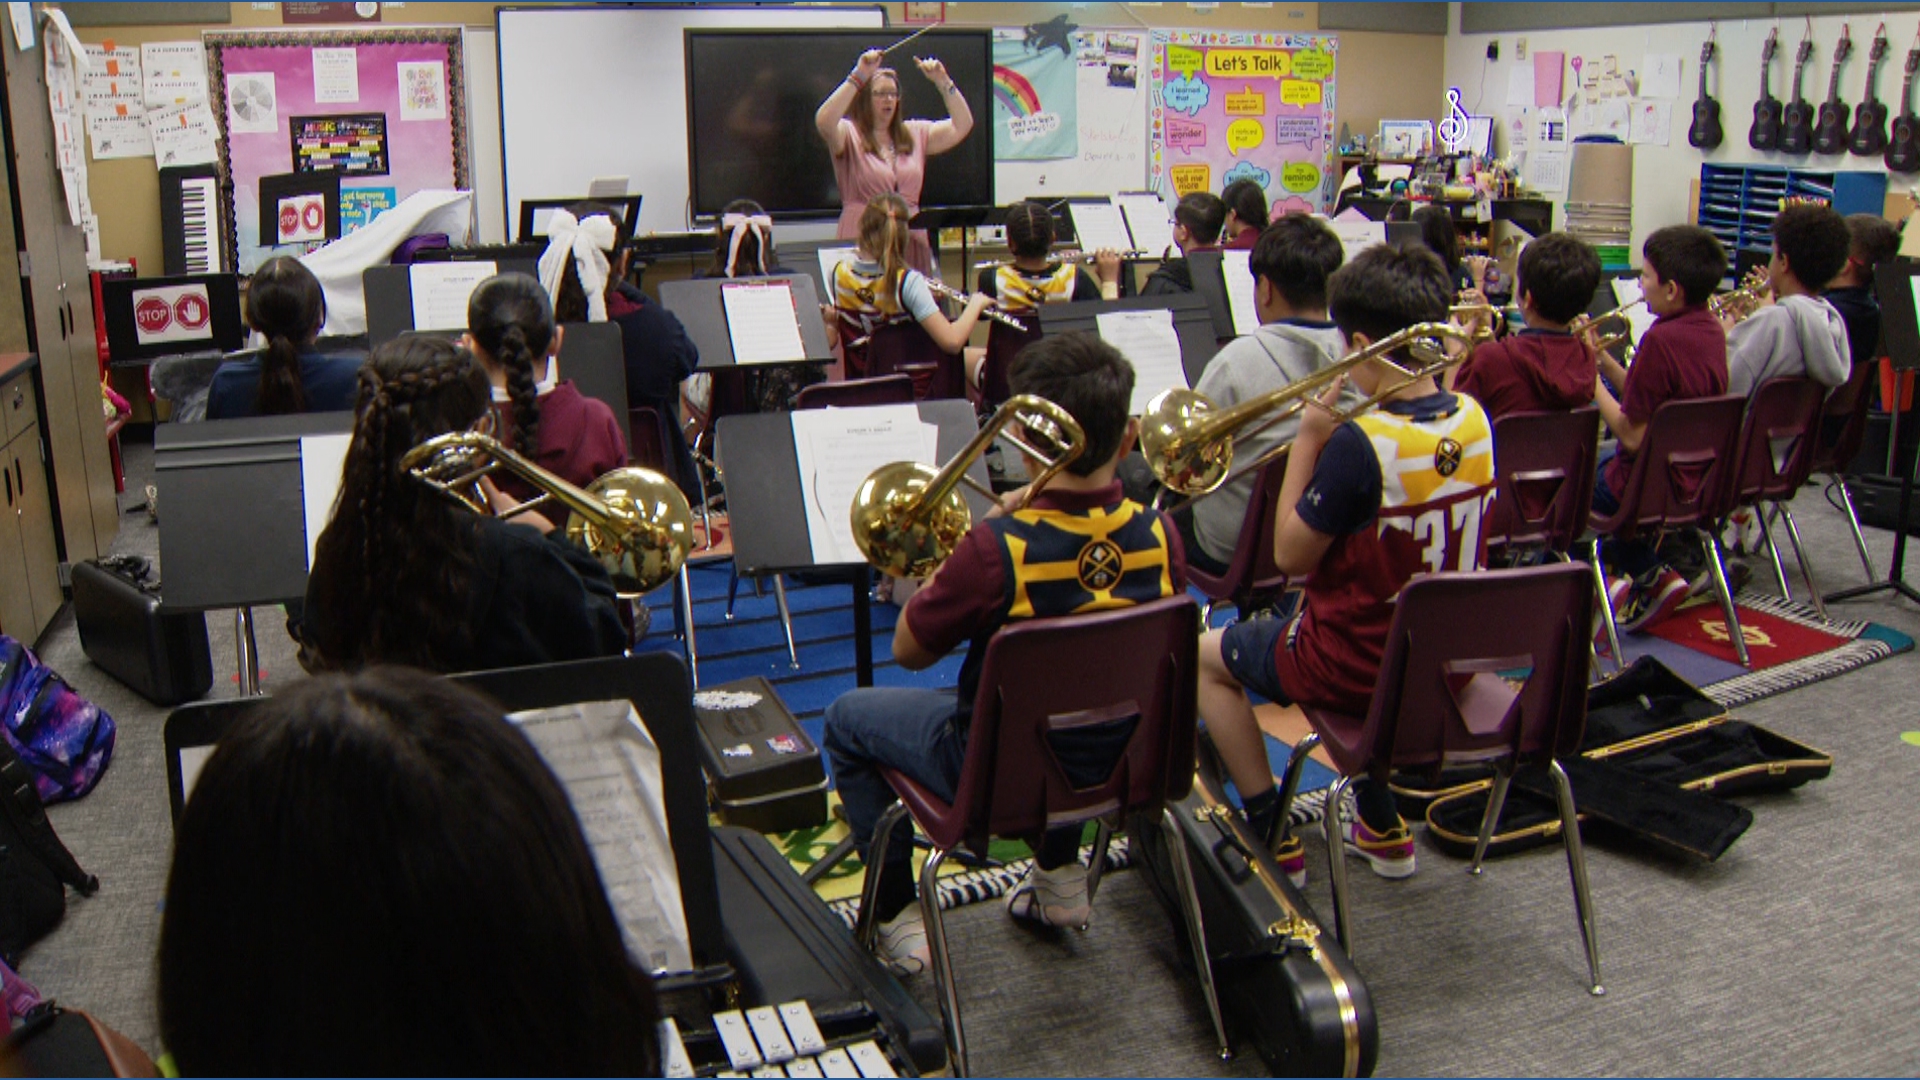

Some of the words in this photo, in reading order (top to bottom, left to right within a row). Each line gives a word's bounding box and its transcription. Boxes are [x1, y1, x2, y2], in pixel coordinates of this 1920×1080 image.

[1214, 56, 1247, 71] Let's
[1253, 56, 1282, 71] Talk
[304, 122, 336, 132] MUSIC
[1171, 129, 1201, 139] wonder
[356, 191, 385, 201] harmony
[280, 215, 297, 226] STOP
[139, 309, 166, 322] STOP
